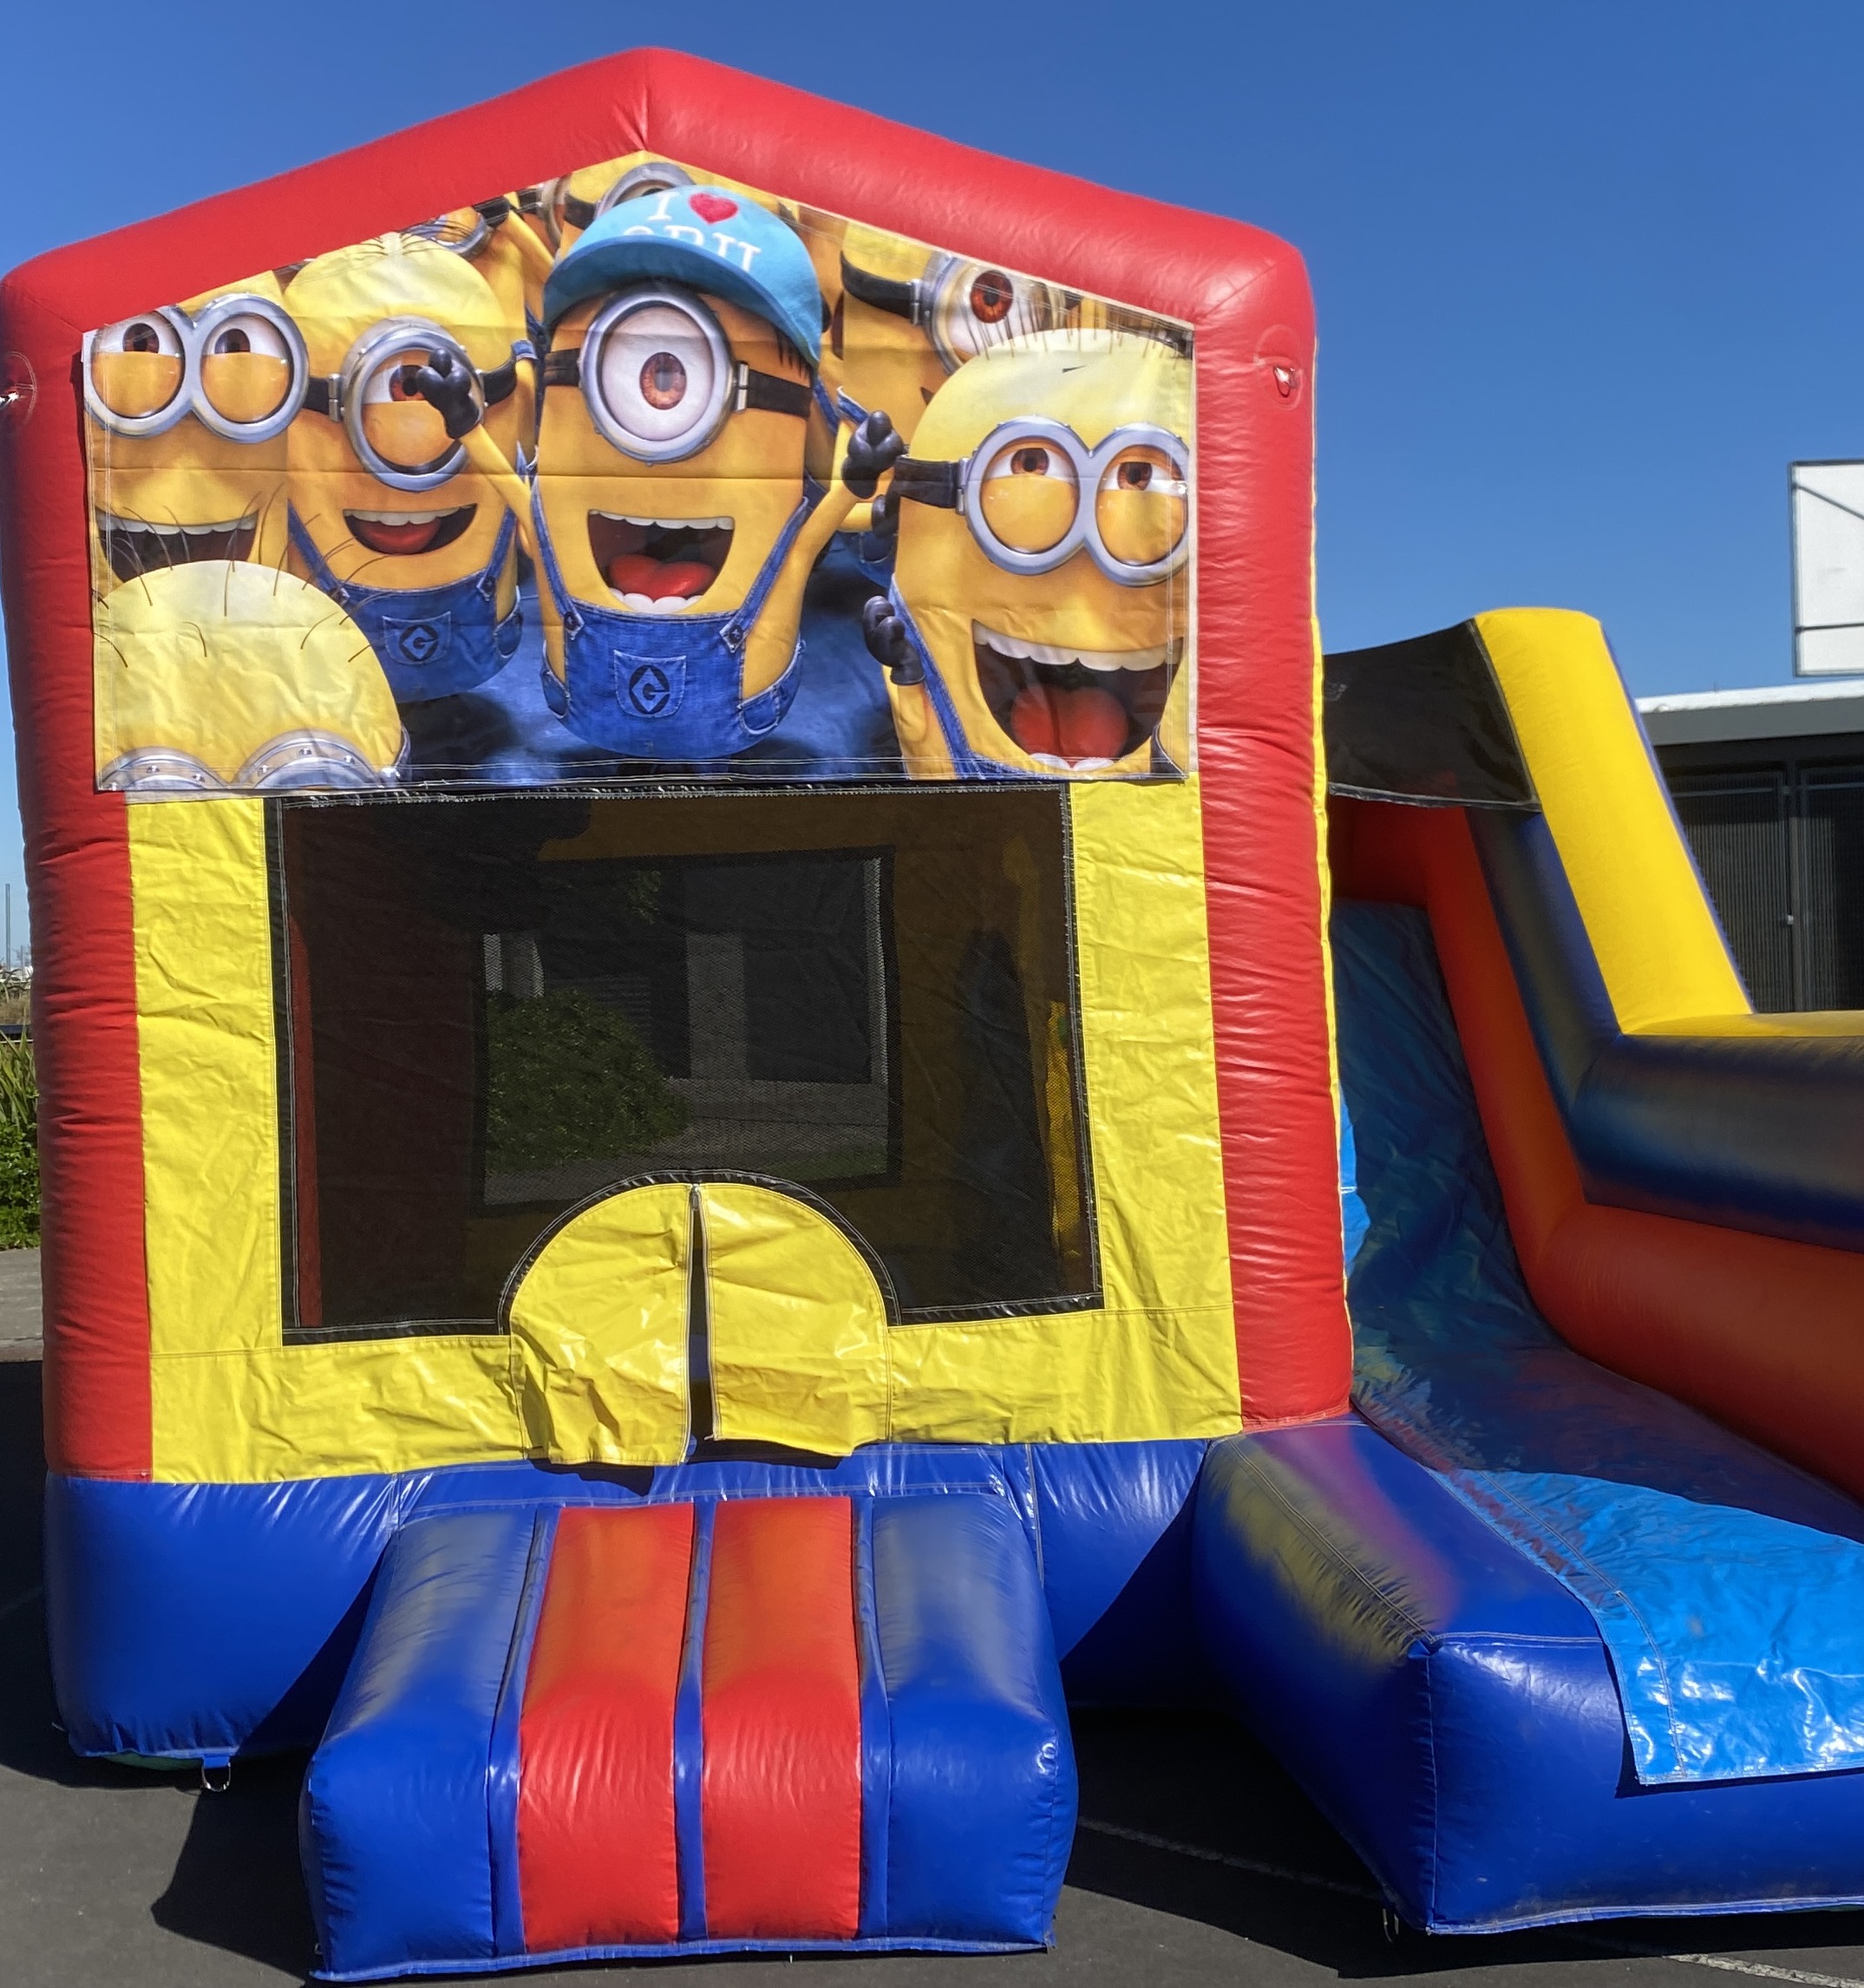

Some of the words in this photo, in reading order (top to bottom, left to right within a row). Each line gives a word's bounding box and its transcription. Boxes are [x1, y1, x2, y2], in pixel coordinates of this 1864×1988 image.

[647, 191, 680, 222] I
[401, 625, 438, 660] G
[630, 665, 670, 714] G
